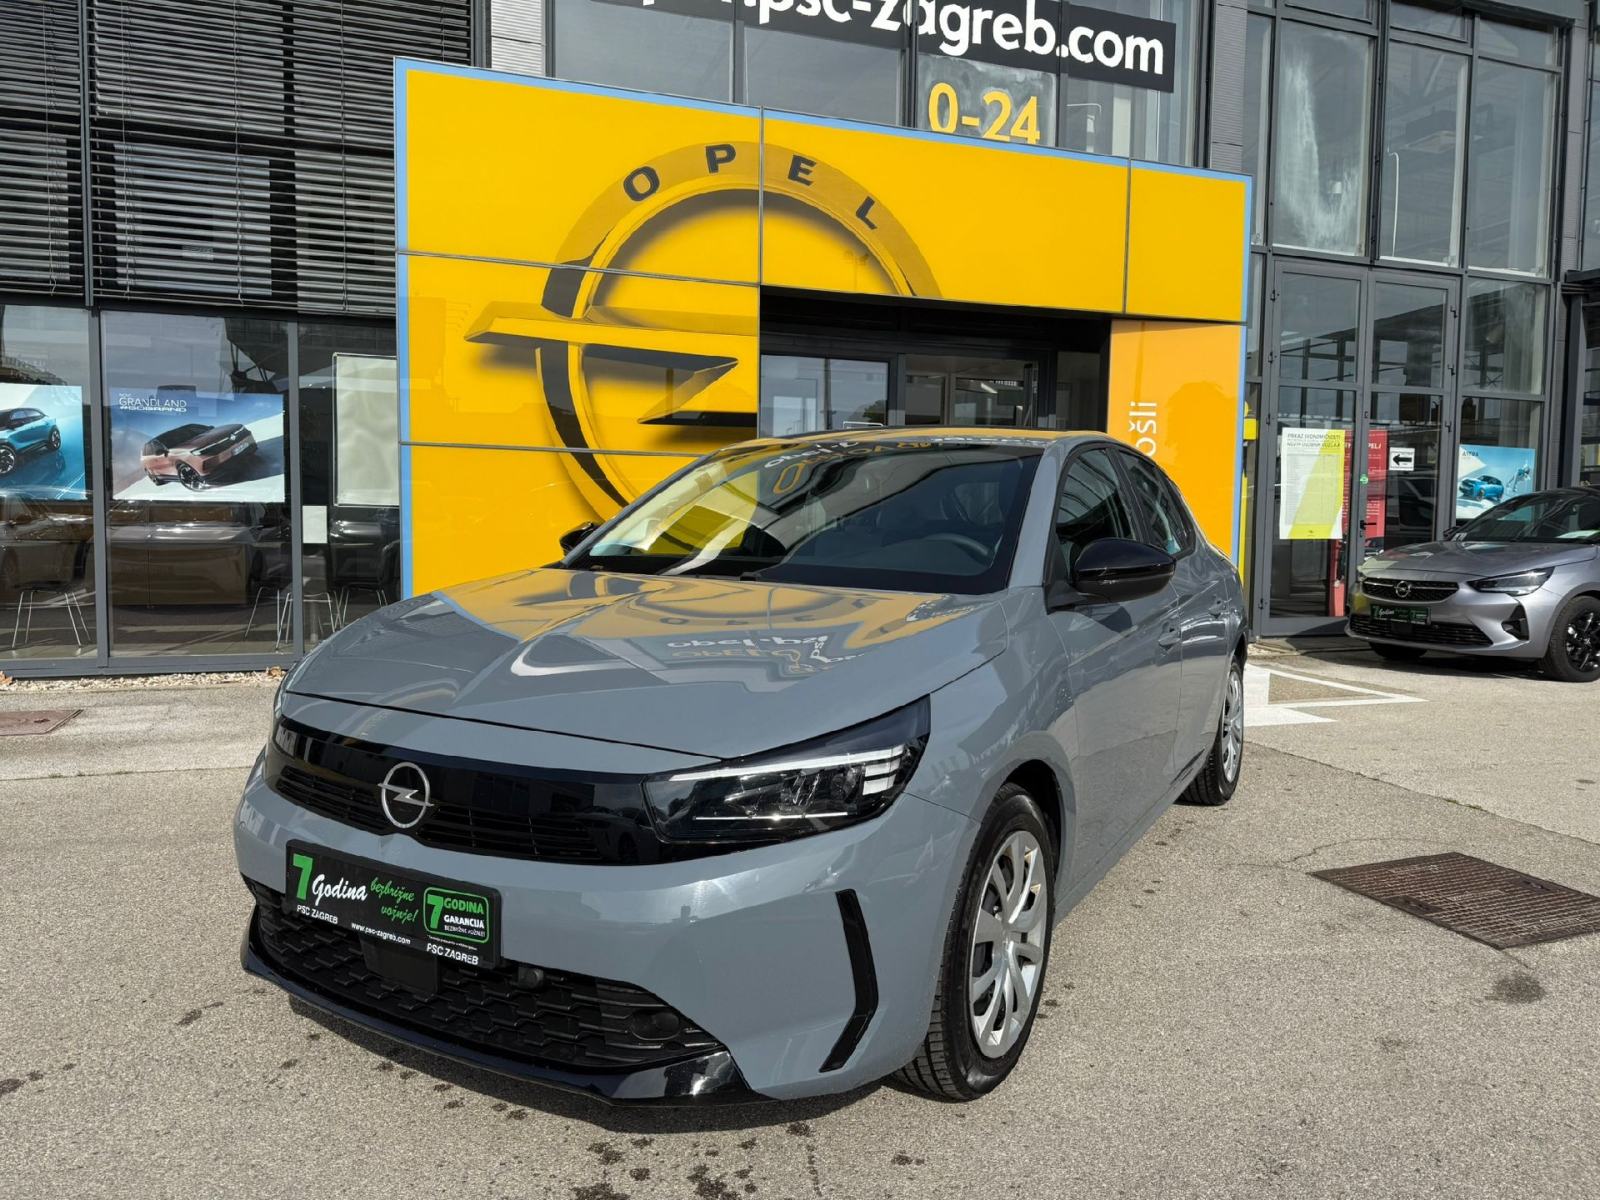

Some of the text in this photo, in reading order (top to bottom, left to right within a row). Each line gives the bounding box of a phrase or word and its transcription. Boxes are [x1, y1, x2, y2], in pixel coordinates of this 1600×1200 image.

[928, 82, 1040, 145] 0-24
[622, 143, 878, 231] OPEL
[119, 397, 187, 409] GRANDLAND
[292, 853, 368, 907] 7 Godina
[296, 904, 339, 925] PSC ZAGREB
[427, 893, 485, 929] 7 GODINA
[443, 914, 485, 929] GARANCIJA
[426, 942, 444, 956] PSC
[444, 947, 479, 966] ZAGREB
